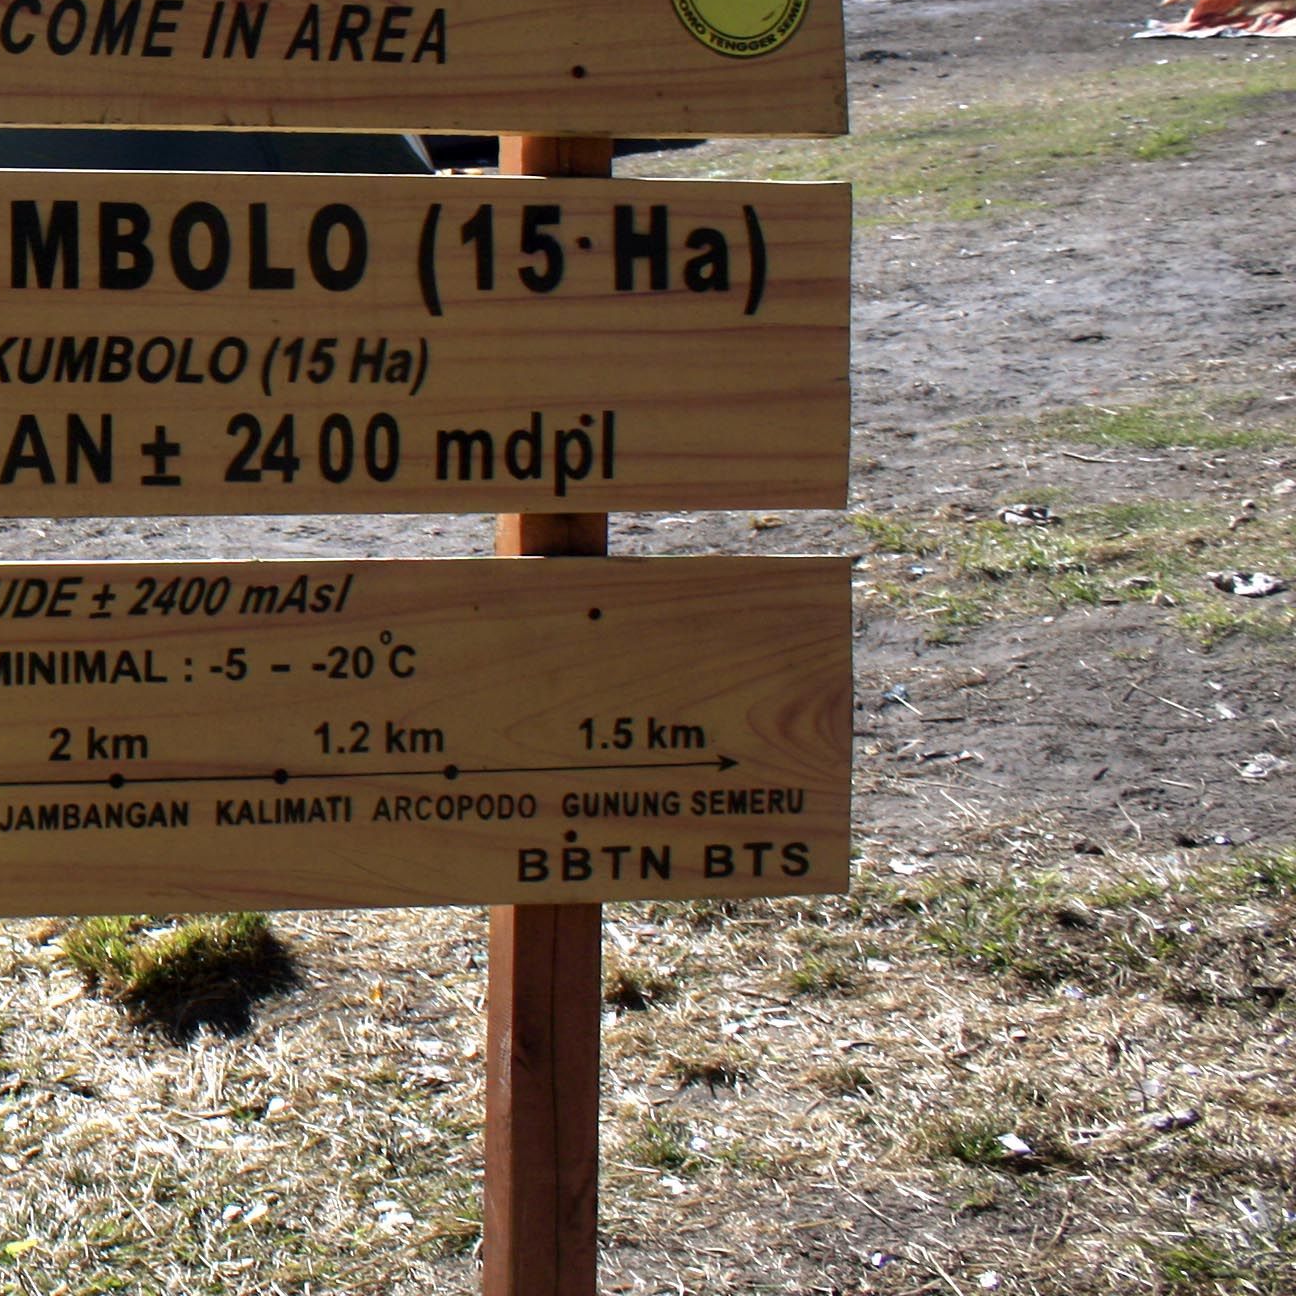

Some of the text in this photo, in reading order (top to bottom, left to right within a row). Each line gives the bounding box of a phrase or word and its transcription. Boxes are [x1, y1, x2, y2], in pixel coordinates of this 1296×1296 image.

[202, 0, 269, 60] IN
[284, 3, 446, 65] AREA
[709, 33, 777, 52] TENGGER
[417, 203, 565, 317] (15
[613, 204, 767, 316] Ha)
[260, 336, 338, 397] (15
[348, 337, 429, 396] Ha)
[140, 425, 182, 487] ±
[224, 412, 400, 484] 2400
[435, 410, 615, 498] mdpl
[89, 583, 116, 620] ±
[127, 575, 233, 617] 2400
[209, 647, 248, 681] -5
[48, 726, 148, 762] 2 km
[314, 720, 444, 754] 1.2 km
[579, 716, 705, 750] 1.5 km
[215, 795, 352, 826] KALIMATI
[372, 793, 537, 822] ARCOPODO
[561, 788, 804, 819] GUNUNG SEMERU
[518, 841, 810, 883] BBTN BTS
